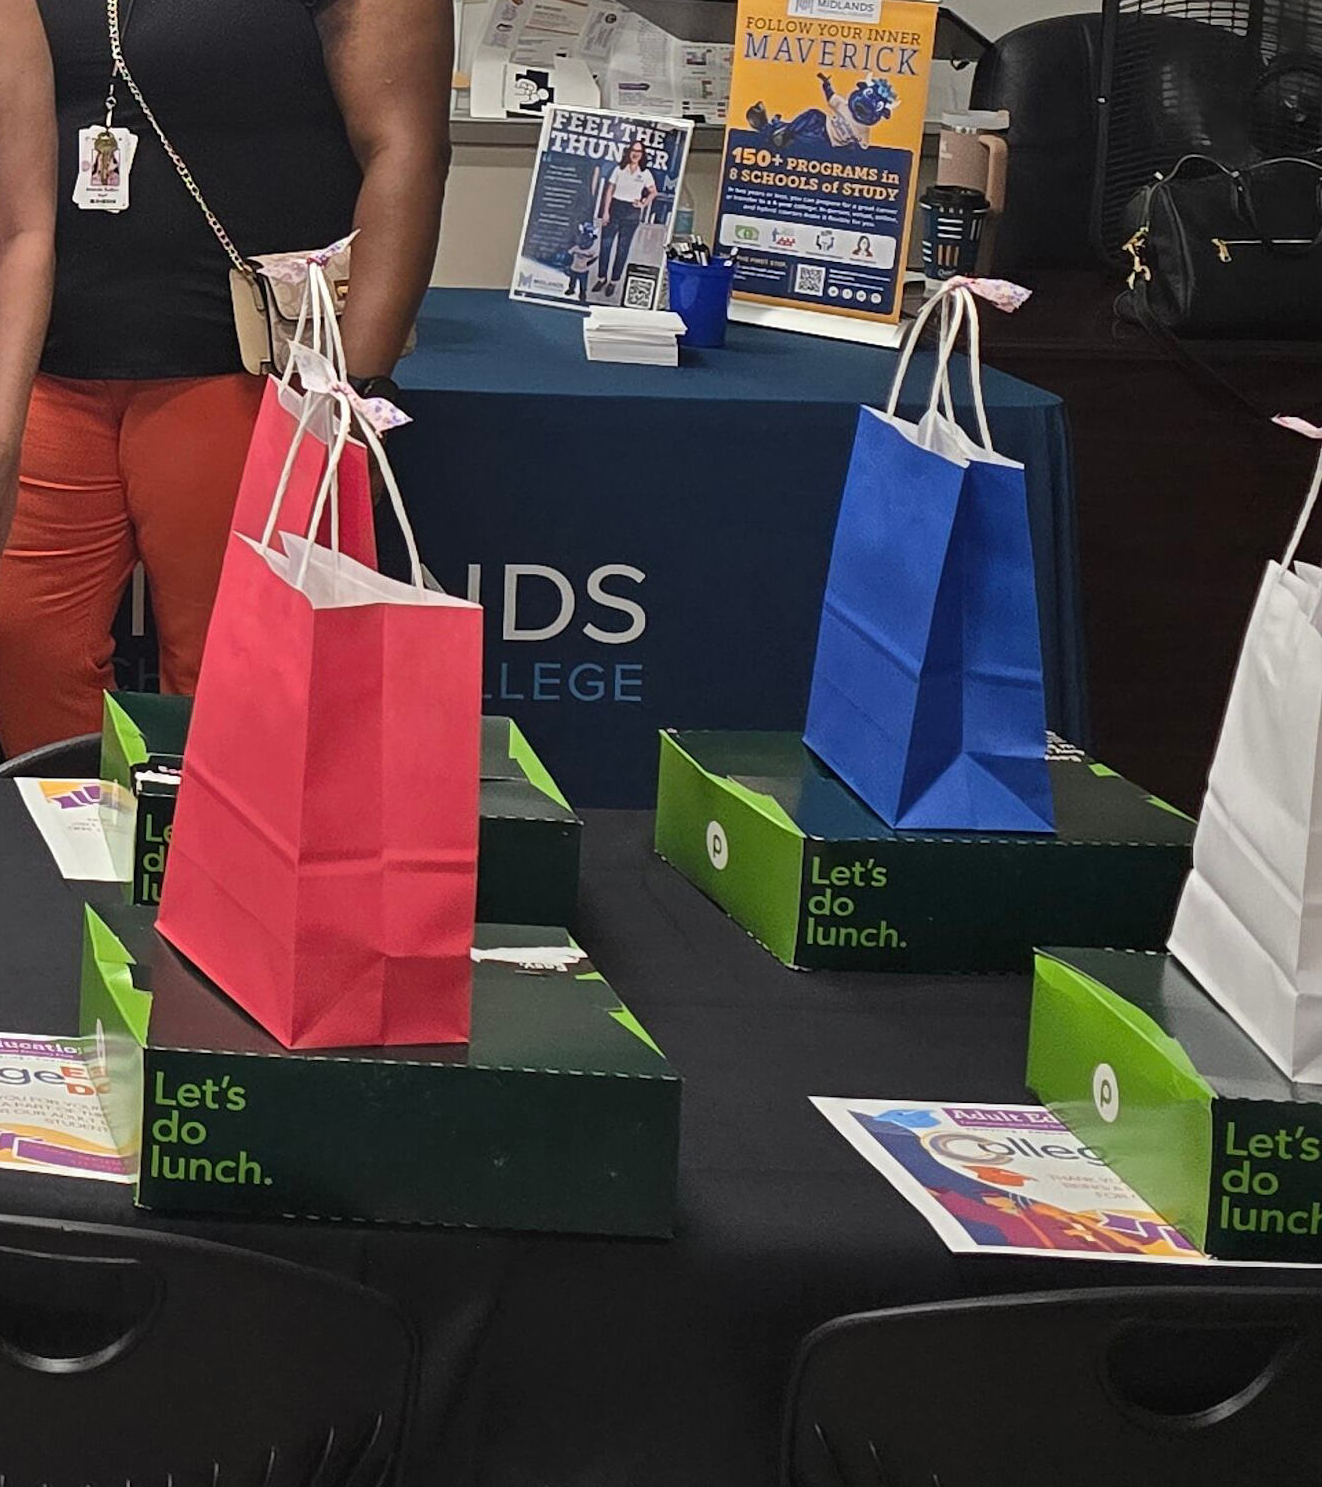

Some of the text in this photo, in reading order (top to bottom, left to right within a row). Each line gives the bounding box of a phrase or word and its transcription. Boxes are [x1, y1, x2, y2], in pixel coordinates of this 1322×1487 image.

[817, 0, 875, 13] MIDLANDS
[746, 16, 921, 45] FOLLOW YOUR INNER
[744, 33, 920, 76] MAVERICK
[553, 110, 666, 149] FEEL THE
[550, 131, 668, 170] THUNER
[732, 147, 900, 185] 150+ PROGRAMS in
[729, 168, 899, 202] 8 SCHOOLS of STUDY
[482, 662, 643, 702] LEGE
[811, 856, 888, 887] Let's
[808, 888, 855, 916] do
[807, 917, 907, 948] lunch.
[155, 1071, 246, 1111] Let's
[152, 1110, 207, 1145] do
[954, 1109, 1024, 1122] Adult
[1226, 1121, 1321, 1162] Let's
[151, 1145, 273, 1186] lunch.
[1222, 1160, 1279, 1195] do
